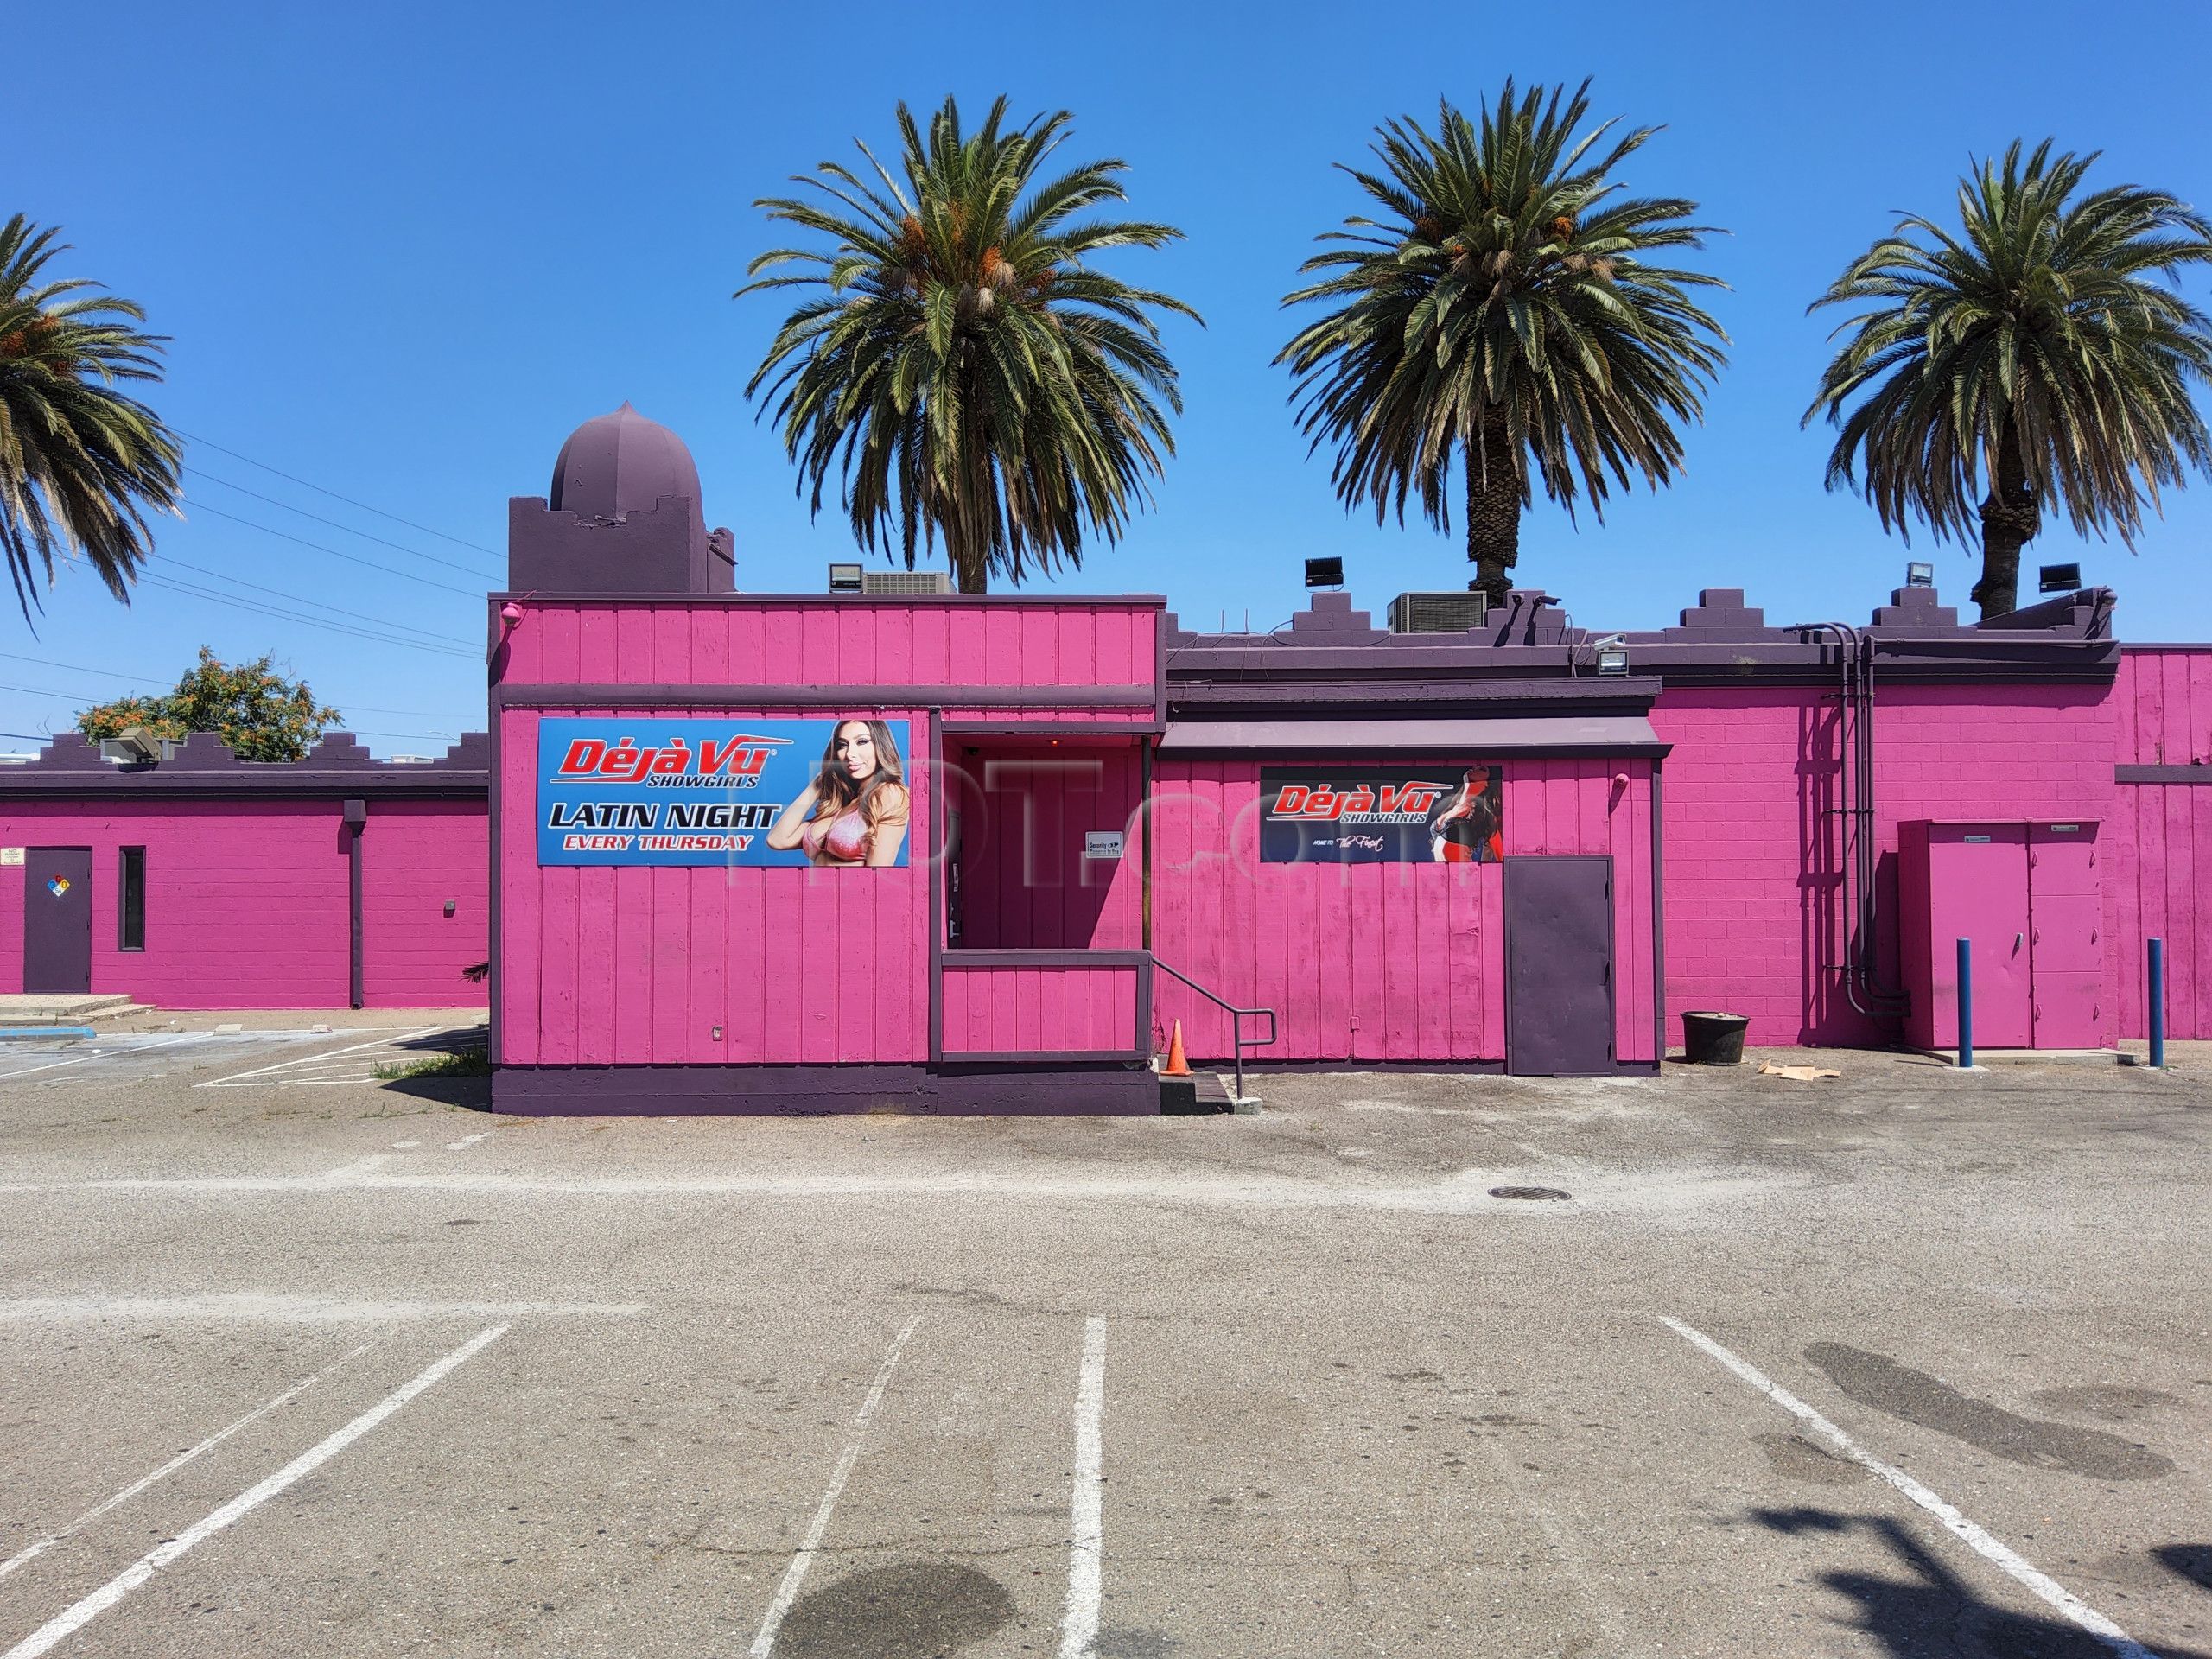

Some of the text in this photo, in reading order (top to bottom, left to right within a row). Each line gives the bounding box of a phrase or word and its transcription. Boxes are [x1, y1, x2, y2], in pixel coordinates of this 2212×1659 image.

[551, 734, 794, 784] Déjà Vu
[646, 774, 760, 789] SHOWGIRLS
[1266, 781, 1454, 821] Déjà Vu
[548, 803, 781, 830] LATIN NIGHT
[1339, 812, 1428, 823] SHOWGIRLS
[563, 835, 754, 851] EVERY THURSDAY
[1336, 835, 1356, 848] The
